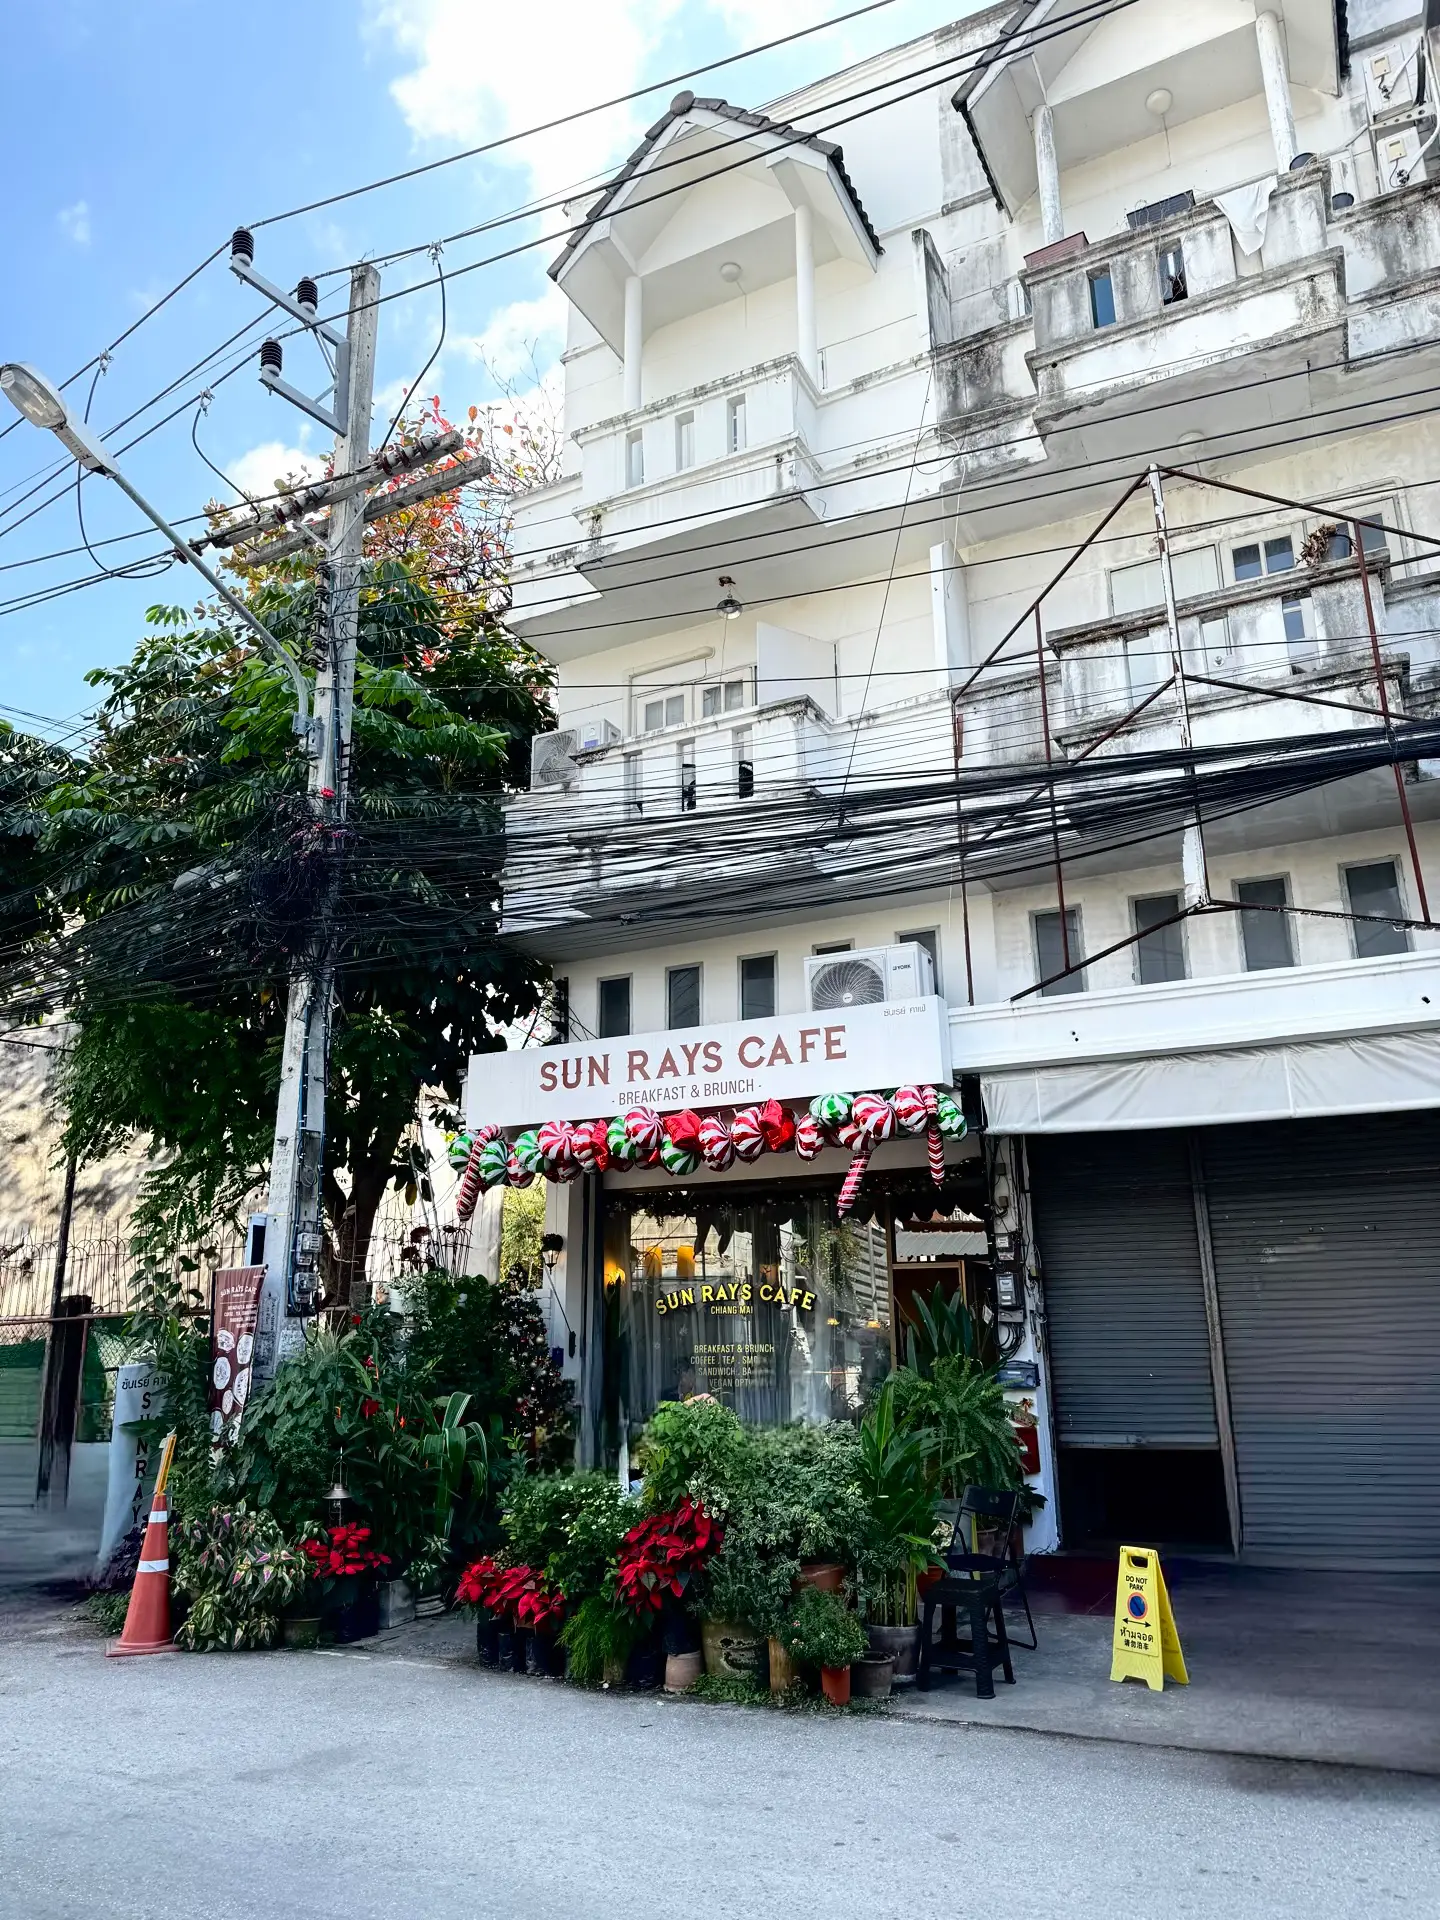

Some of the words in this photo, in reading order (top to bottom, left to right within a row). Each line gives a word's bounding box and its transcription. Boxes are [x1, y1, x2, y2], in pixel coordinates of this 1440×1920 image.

[539, 1053, 611, 1092] SUN
[627, 1041, 723, 1083] RAYS
[737, 1025, 847, 1069] CAFE
[619, 1086, 687, 1106] BREAKFAST
[690, 1084, 700, 1098] &
[704, 1078, 754, 1097] BRUNCH
[655, 1287, 695, 1315] SUN
[701, 1283, 752, 1303] RAYS
[759, 1284, 816, 1311] CAFE
[710, 1305, 737, 1315] CHIANG
[739, 1305, 753, 1314] MAI
[694, 1344, 735, 1354] BREAKFAST
[737, 1344, 743, 1353] &
[744, 1343, 775, 1353] BRUNCH
[690, 1355, 716, 1365] COFFEE
[722, 1355, 735, 1364] TEA
[698, 1367, 736, 1376] SANDWICH
[709, 1378, 733, 1387] VEGAN
[1129, 1583, 1143, 1591] PARK
[1120, 1627, 1153, 1642] ห้ามจอด
